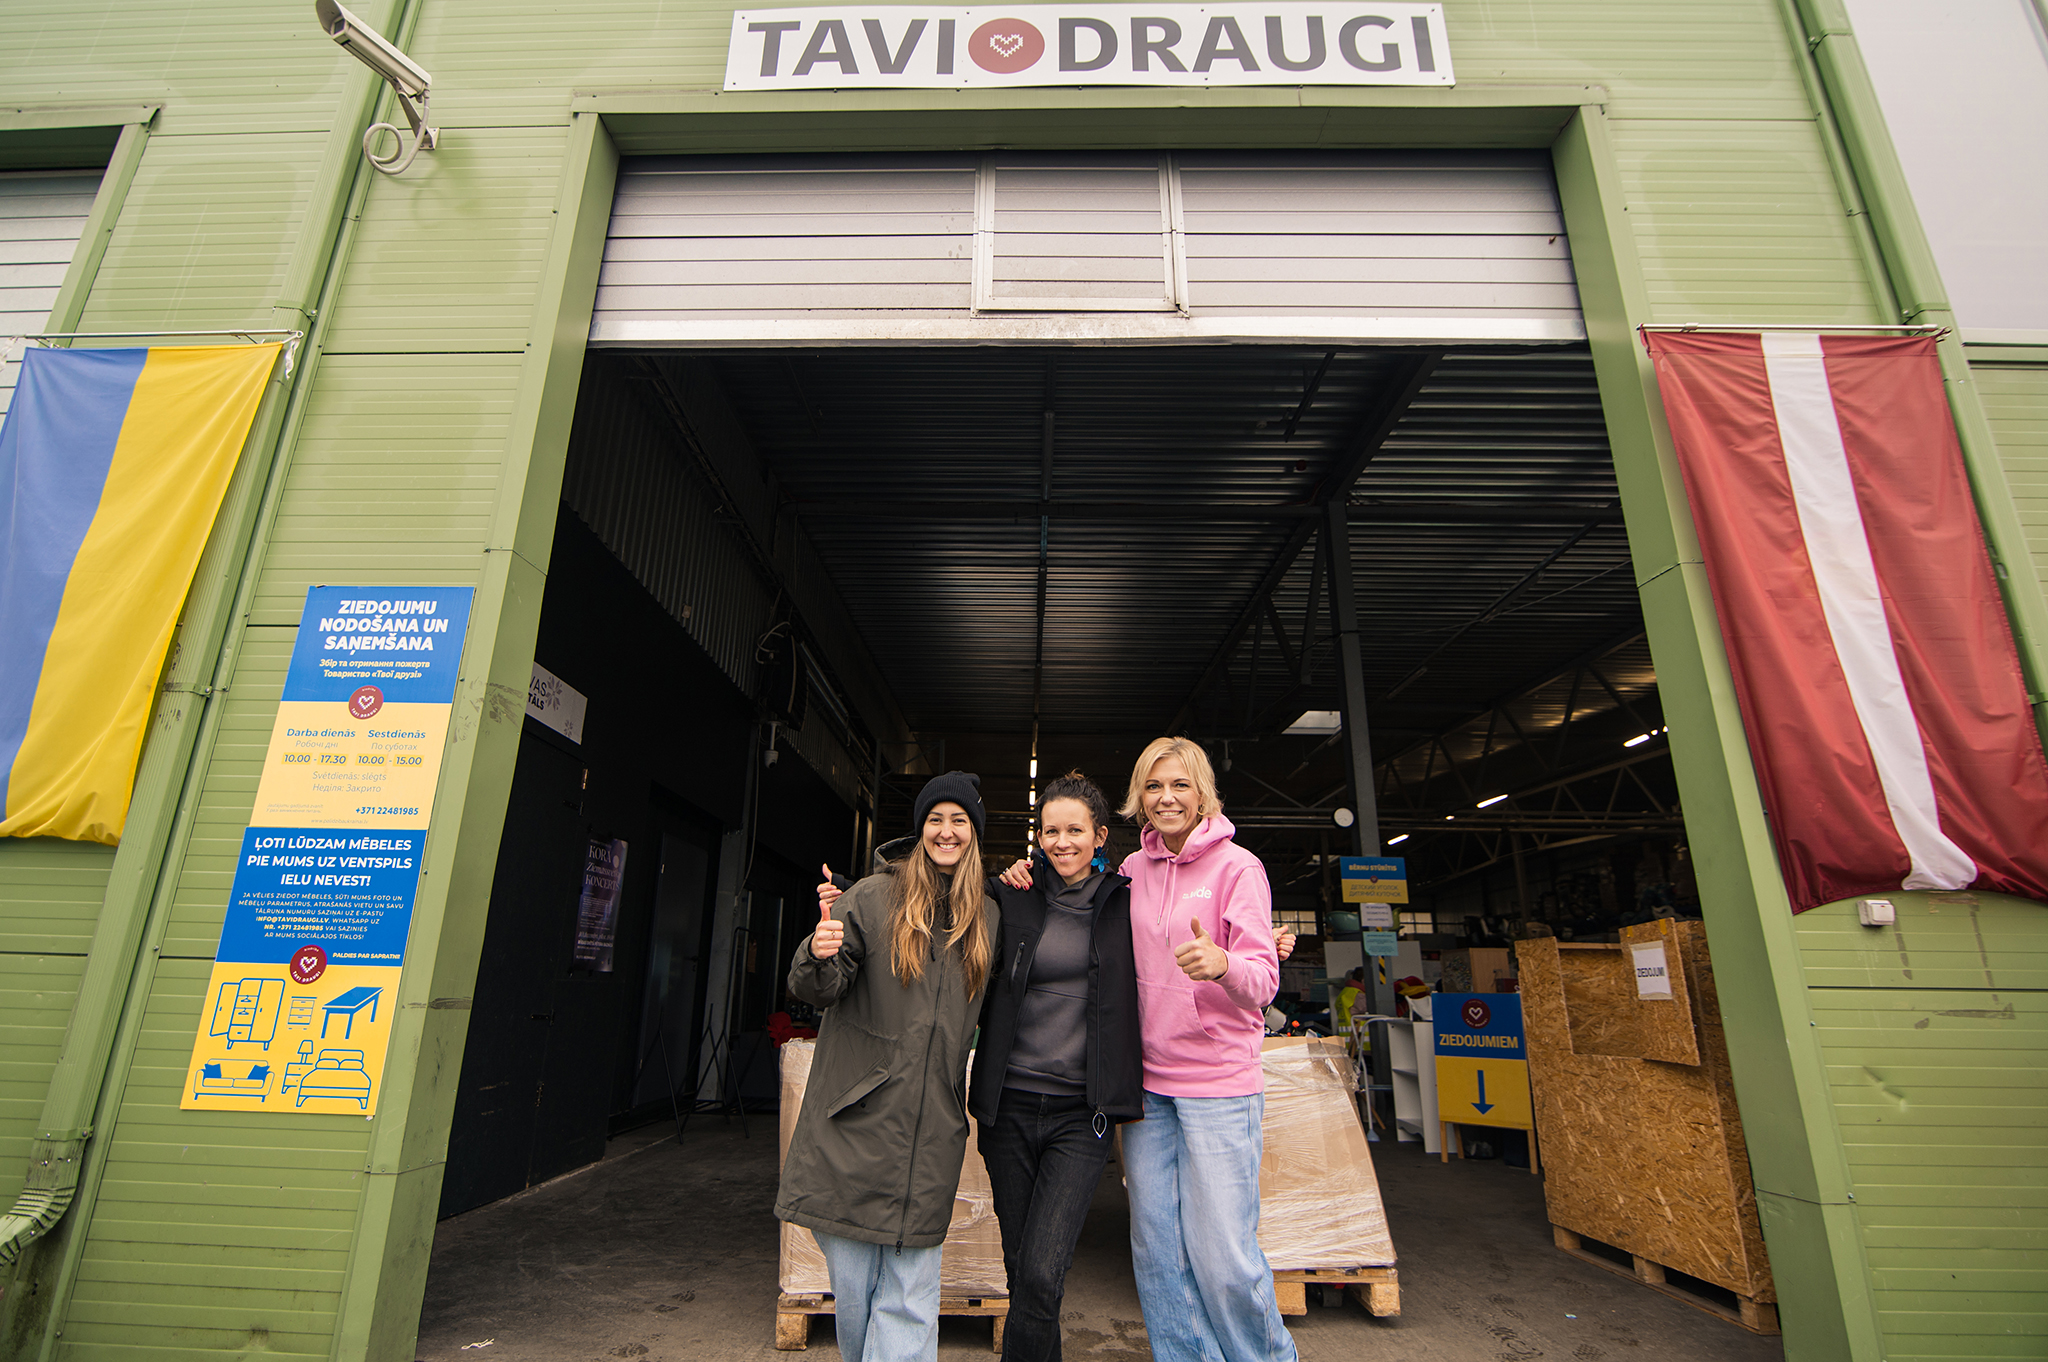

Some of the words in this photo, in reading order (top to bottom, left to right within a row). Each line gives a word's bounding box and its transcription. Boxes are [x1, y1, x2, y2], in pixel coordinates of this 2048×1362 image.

[747, 19, 954, 77] TAVI
[1058, 15, 1436, 73] DRAUGI
[338, 600, 437, 615] ZIEDOJUMU
[319, 614, 419, 633] NODOŠANA
[422, 618, 449, 633] UN
[324, 632, 434, 656] SAŅEMŠANA
[319, 658, 337, 669] Збір
[338, 660, 348, 668] та
[349, 660, 394, 669] отримання
[394, 660, 431, 669] пожертв
[323, 669, 371, 679] Товариство
[286, 728, 319, 738] Darba
[320, 728, 356, 738] dienās
[367, 729, 426, 739] Sestdienās
[295, 740, 324, 749] Робочі
[324, 741, 339, 750] дні
[371, 742, 383, 750] По
[384, 743, 418, 754] суботах
[284, 754, 311, 763] 10.00
[320, 755, 347, 765] 17.30
[357, 755, 385, 765] 10.00
[396, 756, 422, 766] 15.00
[312, 771, 360, 780] Svētdienās:
[361, 772, 387, 782] slēgts
[312, 783, 345, 793] Неділя:
[345, 784, 382, 794] Закрито
[355, 806, 376, 815] +371
[376, 807, 419, 816] 22481985
[254, 837, 286, 852] ĻOTI
[288, 836, 346, 850] LŪDZAM
[348, 836, 412, 851] MĒBELES
[589, 844, 612, 863] KORA
[247, 855, 270, 867] PIE
[272, 855, 315, 867] MUMS
[317, 856, 336, 868] UZ
[339, 857, 413, 869] VENTSPILS
[280, 874, 312, 886] IELU
[314, 874, 372, 887] NEVEST!
[585, 874, 620, 891] KONCERTS
[252, 891, 275, 899] VĒLIES
[301, 892, 333, 900] MĒBELES,
[238, 899, 266, 907] MĒBEĻU
[266, 900, 312, 908] PARAMETRUS,
[313, 900, 352, 908] ATRAŠANĀS
[255, 907, 285, 916] TĀLRUŅA
[317, 909, 344, 917] SAZIŅAI
[297, 931, 338, 940] SOCIĀLAJOS
[339, 932, 364, 940] TĪKLOS!
[1439, 1033, 1519, 1049] ZIEDOJUMIEM
